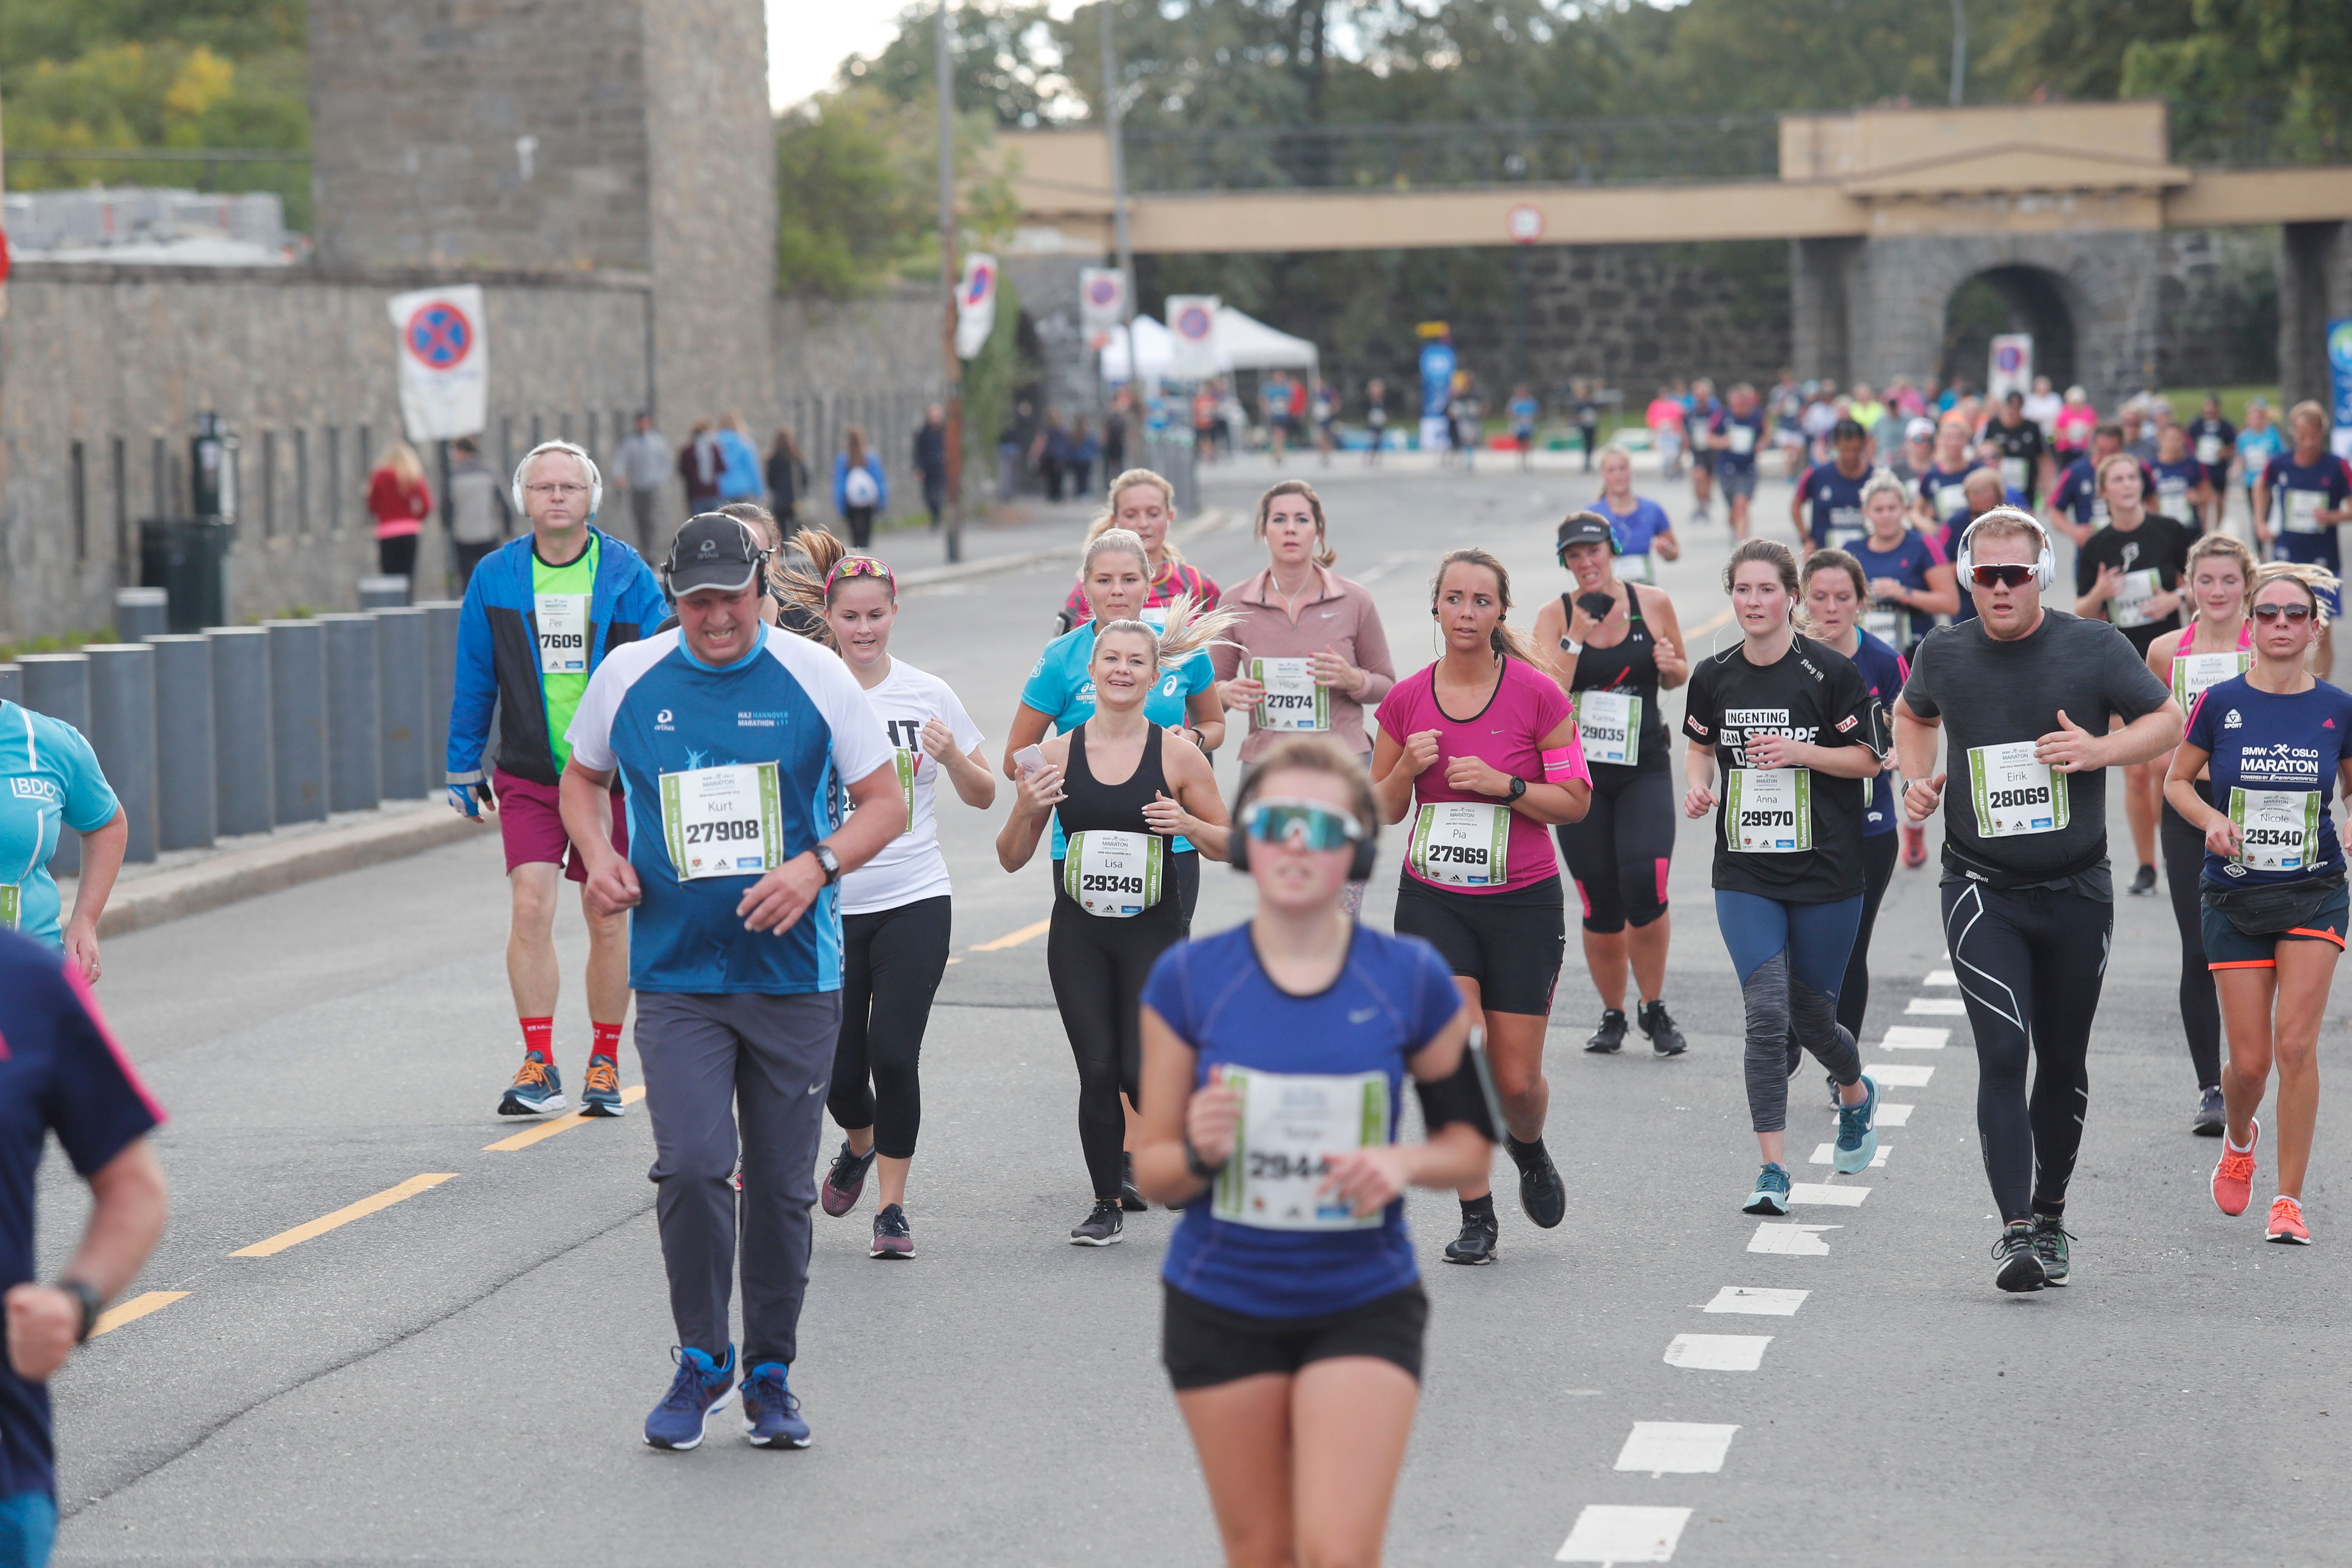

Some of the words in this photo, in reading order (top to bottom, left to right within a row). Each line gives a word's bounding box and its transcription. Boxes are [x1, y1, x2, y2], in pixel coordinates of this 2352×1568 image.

[697, 550, 719, 558] artiva
[549, 619, 563, 628] Per
[1801, 659, 1817, 674] Stay
[1816, 671, 1824, 681] fit
[1268, 695, 1313, 708] 27874
[1727, 712, 1786, 723] INGENTING
[1582, 726, 1624, 741] 29035
[1722, 732, 1739, 743] KAN
[2242, 747, 2267, 756] BMW
[2291, 748, 2318, 758] OSLO
[2240, 758, 2318, 774] MARATON
[2008, 771, 2027, 782] Eirik
[703, 779, 734, 787] MARATON
[1756, 795, 1777, 804] Anna
[1990, 787, 2049, 808] 28069
[2056, 780, 2065, 825] Halvmaraton
[708, 801, 732, 812] Kurt
[1978, 789, 1991, 834] Halvmaraton
[1742, 811, 1793, 826] 29970
[2260, 814, 2289, 823] Nicole
[686, 820, 759, 845] 27908
[1453, 829, 1466, 839] Pia
[2245, 829, 2303, 846] 29340
[1429, 845, 1488, 865] 27969
[1105, 859, 1123, 868] Lisa
[1966, 871, 1988, 882] FlipBelt
[1083, 875, 1142, 894] 29349
